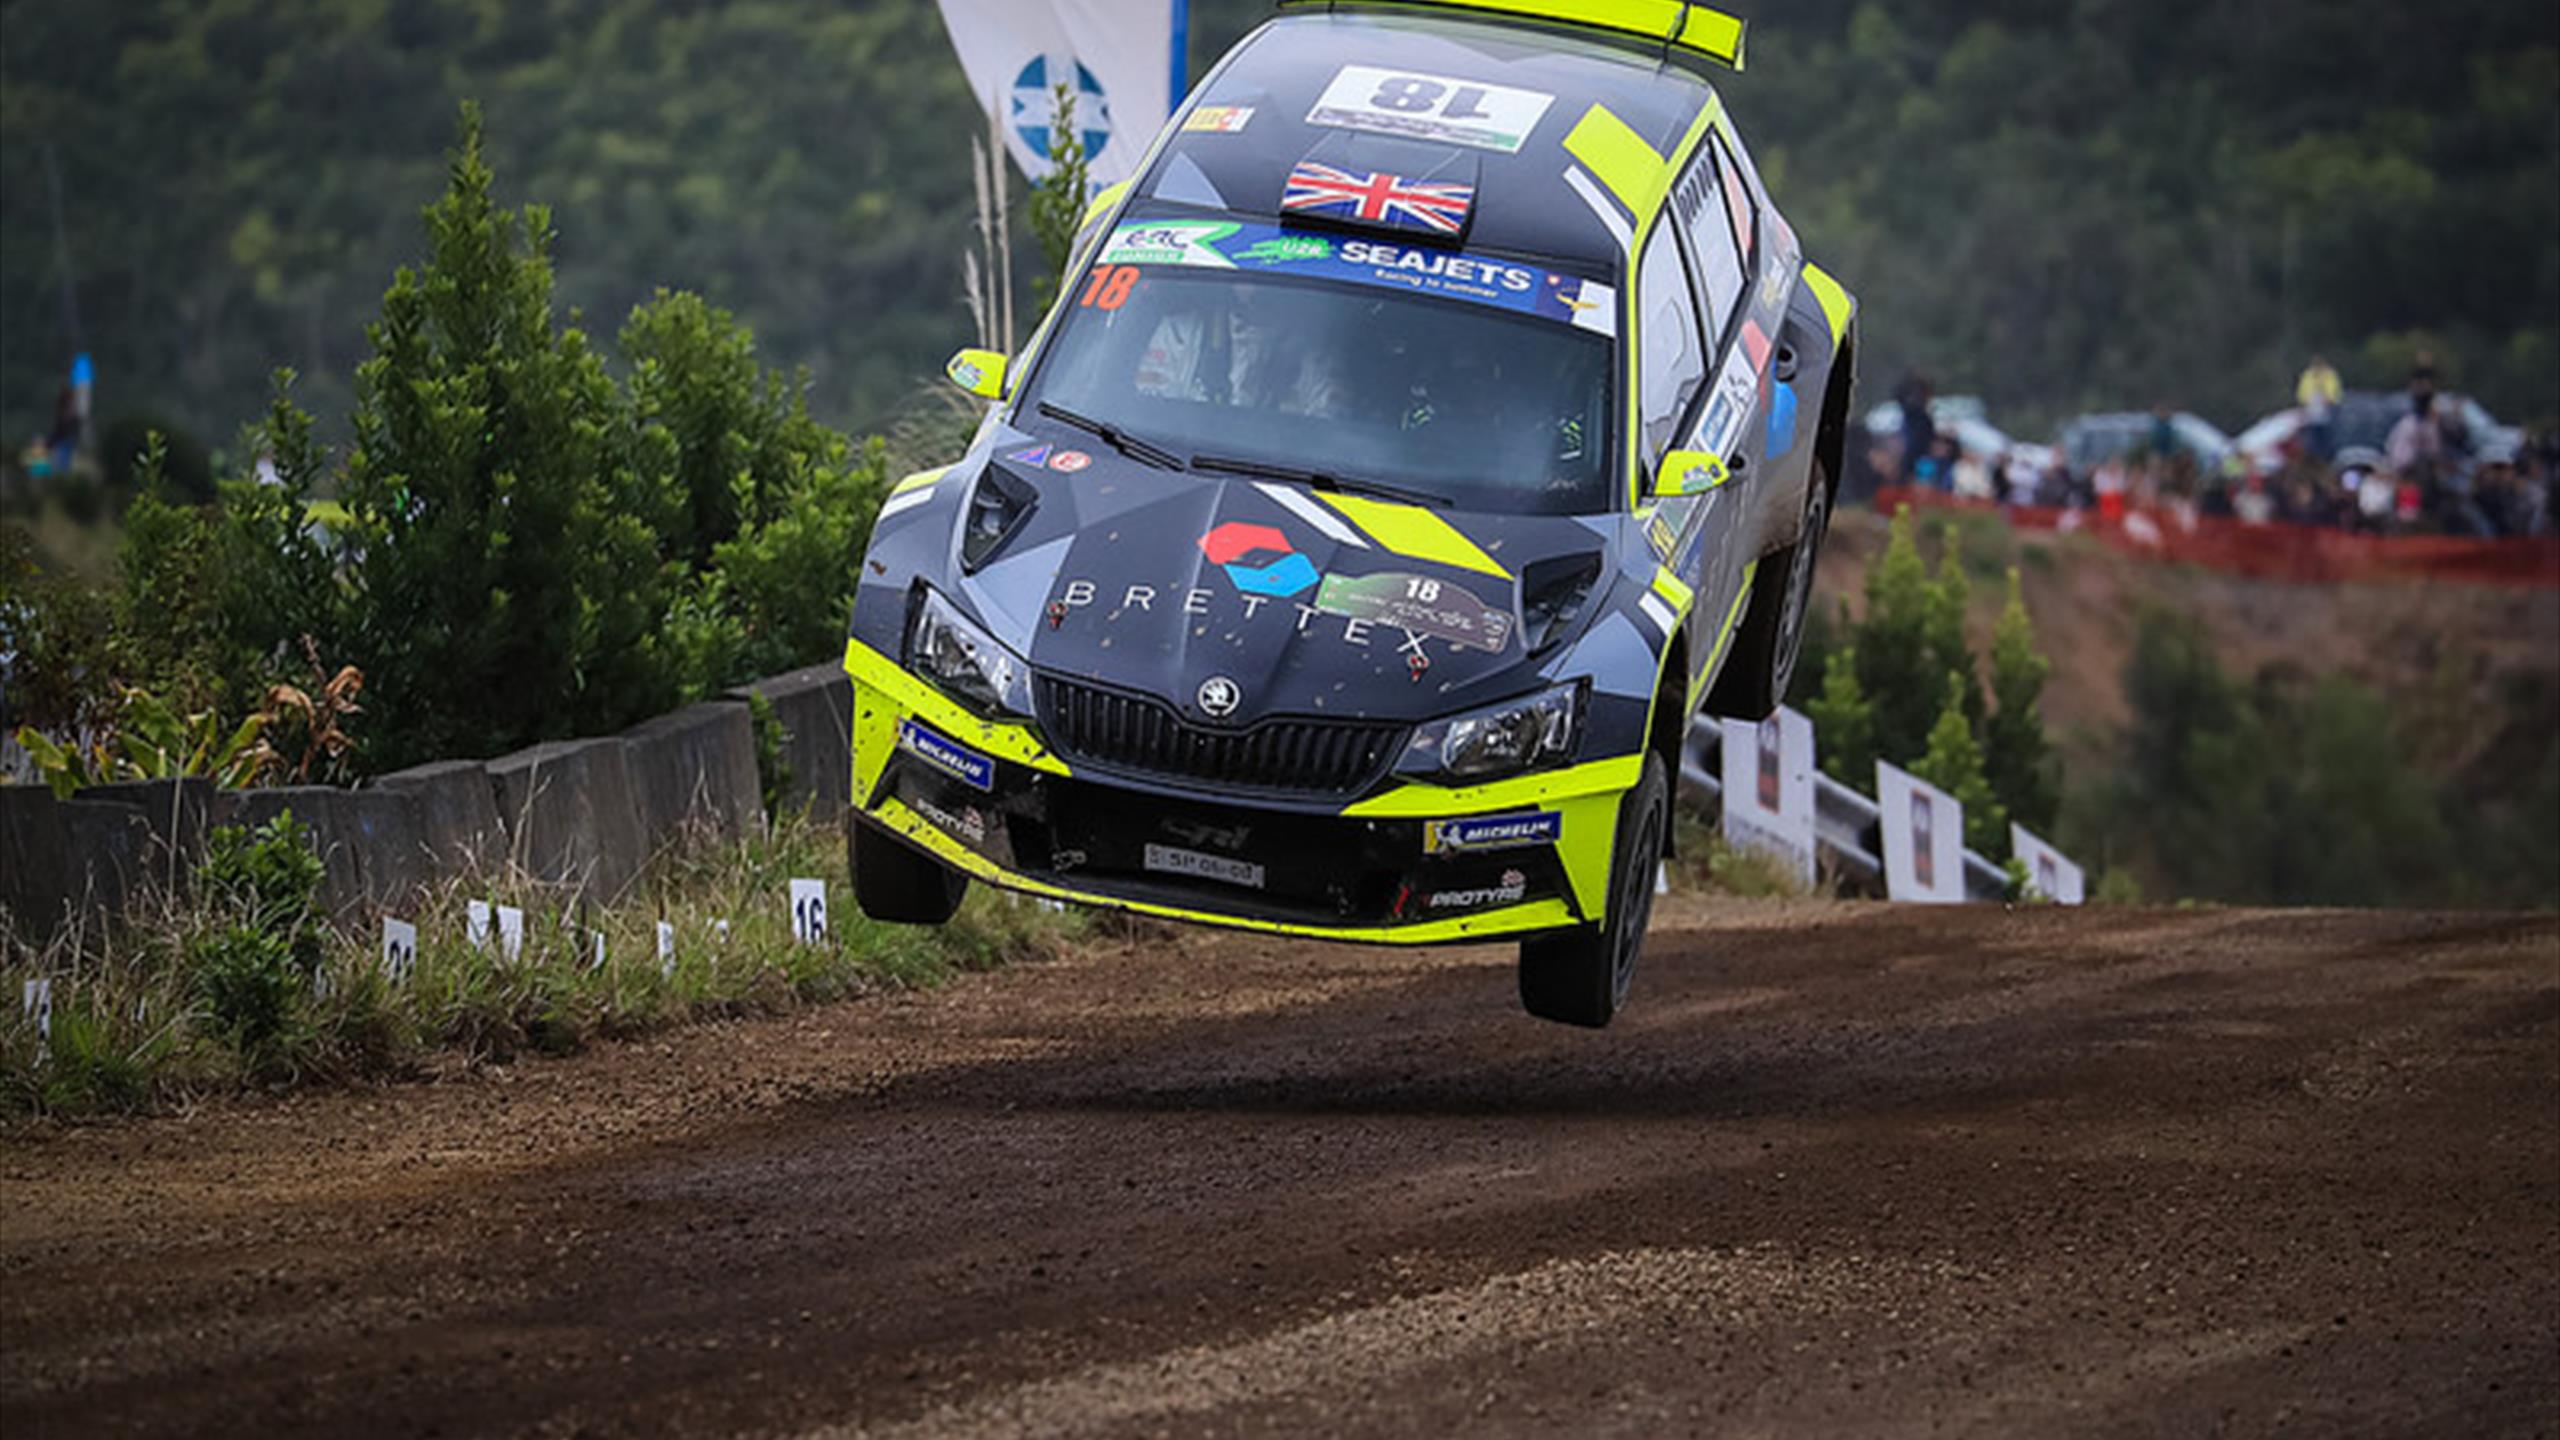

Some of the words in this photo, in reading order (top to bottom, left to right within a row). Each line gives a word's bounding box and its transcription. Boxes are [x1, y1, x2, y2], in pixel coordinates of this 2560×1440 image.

[1369, 76, 1490, 120] 18
[1080, 264, 1141, 310] 18
[1339, 240, 1532, 291] SEAJETS
[1405, 577, 1441, 602] 18
[1064, 579, 1430, 657] BRETTEX
[1465, 821, 1552, 841] MICHELIN
[796, 896, 825, 941] 16
